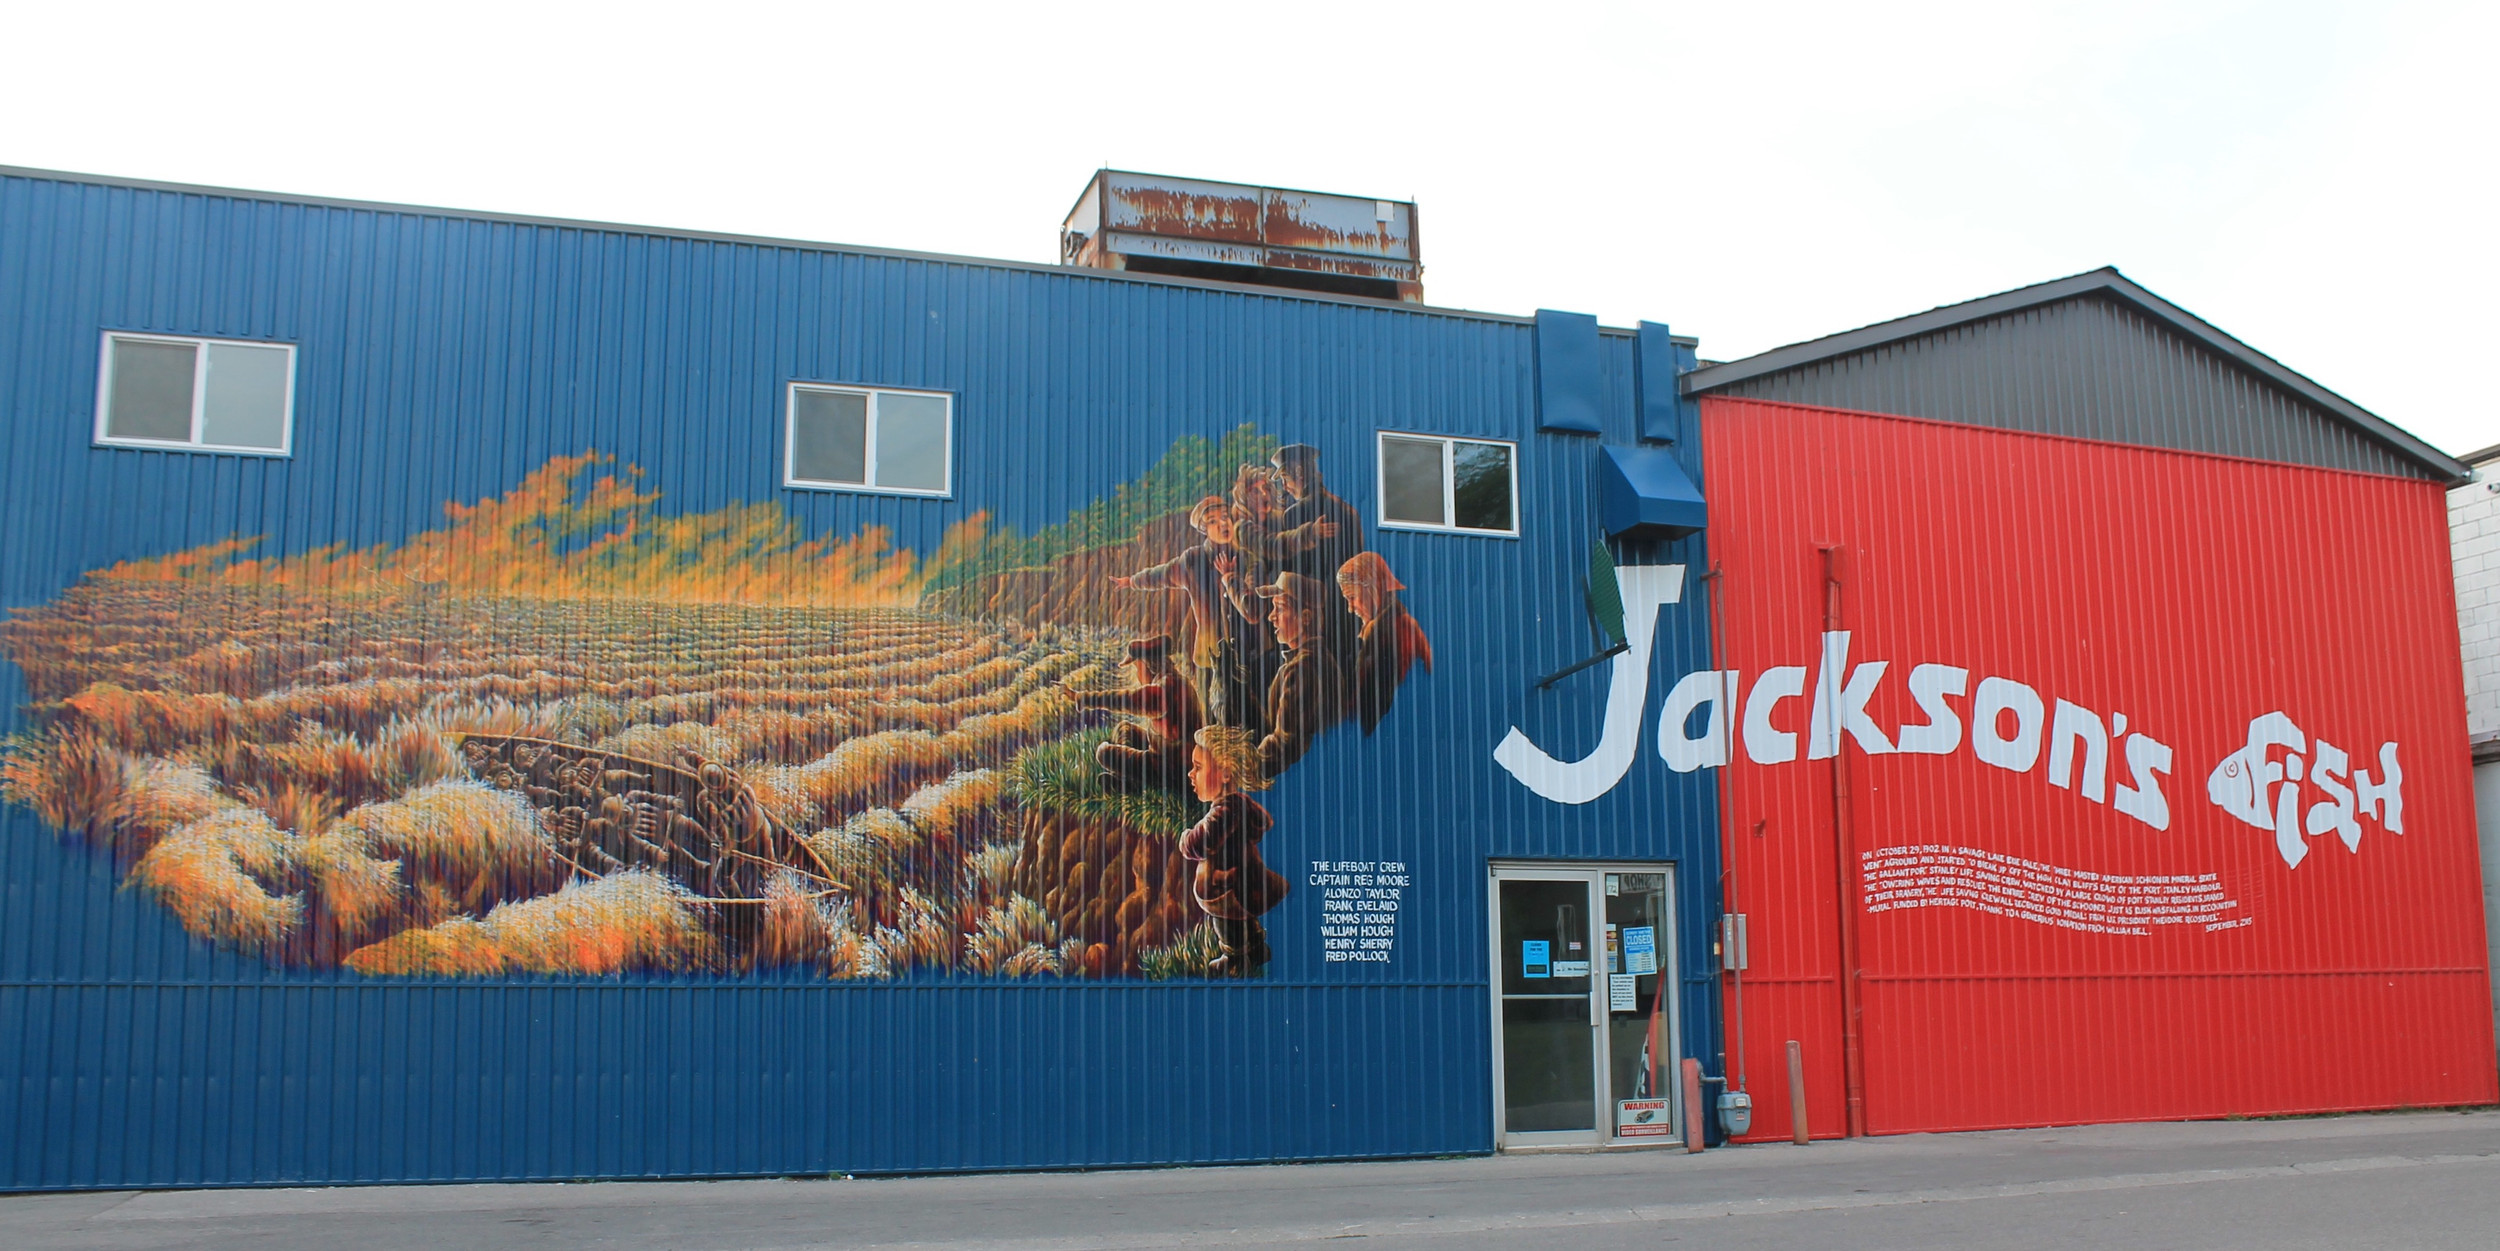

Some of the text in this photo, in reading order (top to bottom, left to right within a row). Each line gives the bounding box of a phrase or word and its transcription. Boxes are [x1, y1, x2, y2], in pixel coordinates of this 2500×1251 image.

[1493, 564, 2173, 831] Jackson's
[1312, 861, 1406, 873] THE LIFEBOAT CREW
[1309, 874, 1411, 887] CAPTAIN REG MOORE
[1324, 888, 1400, 900] ALONZO TAYLOR
[1941, 877, 1956, 886] AND
[1987, 884, 2001, 894] THE
[2046, 896, 2057, 905] OF
[2057, 898, 2071, 908] THE
[1325, 900, 1398, 912] FRANK EVELAND
[1323, 913, 1395, 925] THOMAS HOUGH
[2005, 908, 2015, 918] TO
[1320, 925, 1393, 937] WILLIAM HOUGH
[1325, 938, 1393, 950] HENRY SHERRY
[1626, 934, 1652, 946] CLOSED
[1325, 950, 1348, 963] FRED
[1624, 1102, 1665, 1110] WARNING
